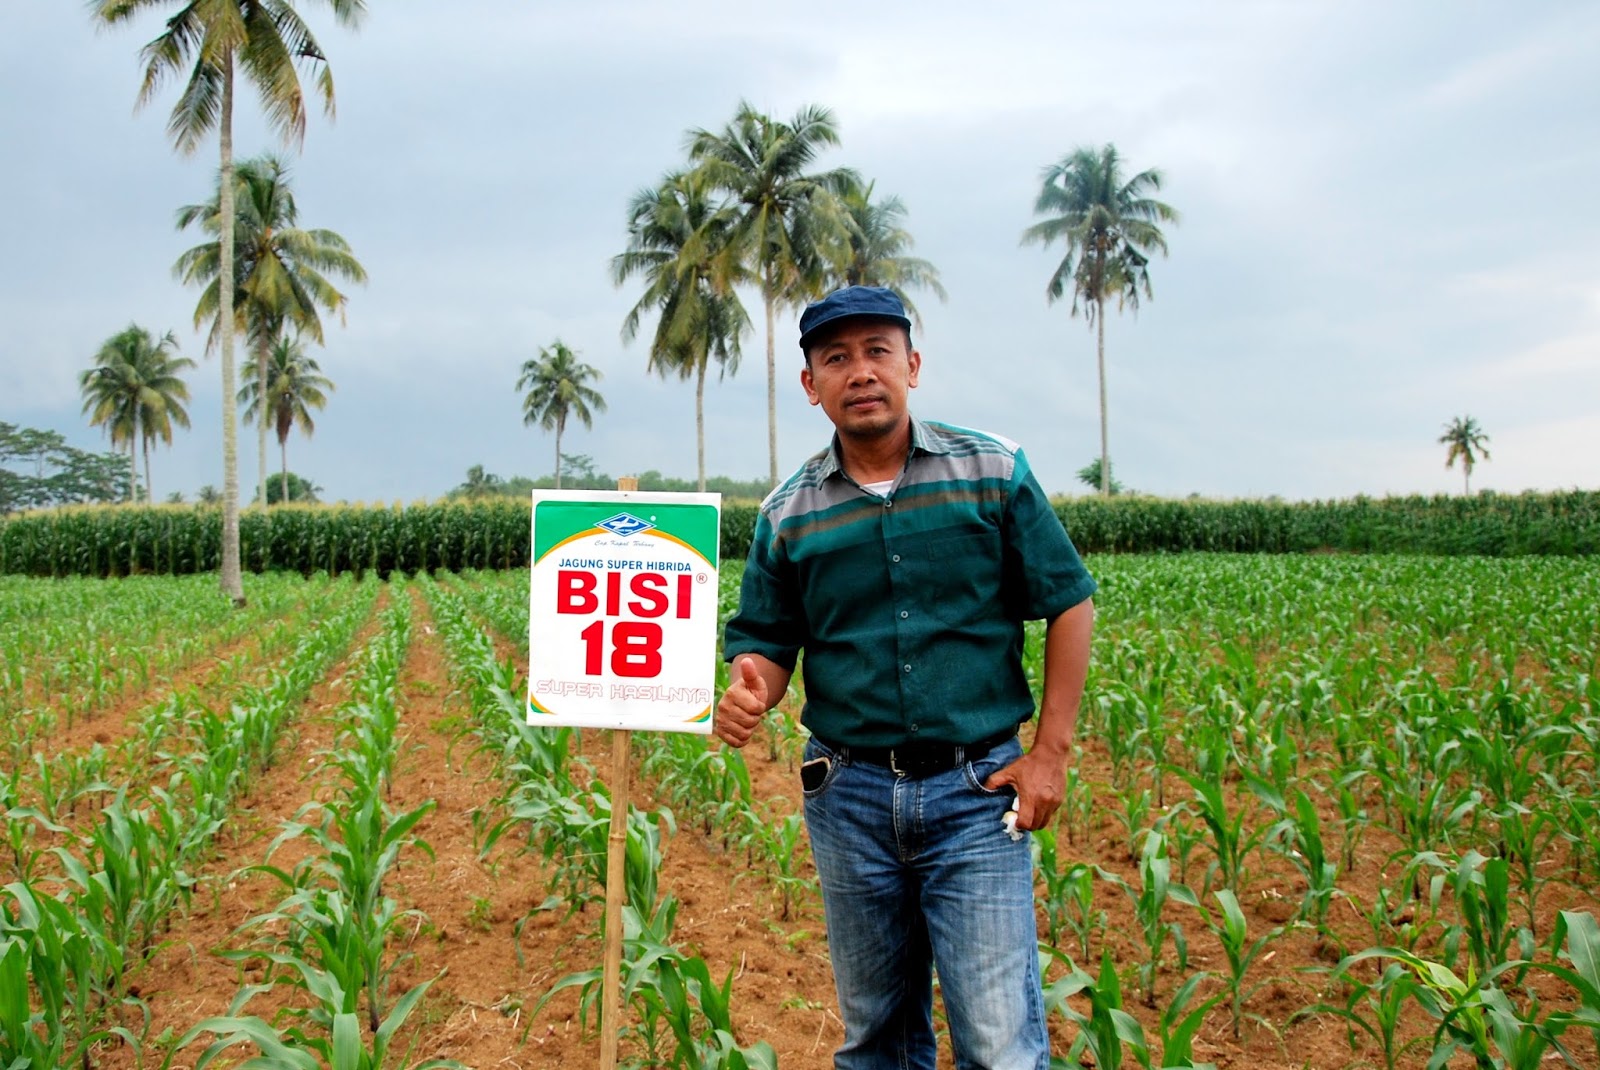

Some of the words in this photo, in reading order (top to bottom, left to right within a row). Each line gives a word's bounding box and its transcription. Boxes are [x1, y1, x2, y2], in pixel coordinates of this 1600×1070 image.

[558, 558, 604, 569] JAGUNG
[607, 559, 643, 570] SUPER
[646, 561, 692, 572] HIBRIDA
[557, 570, 692, 619] BISI
[581, 620, 663, 678] 18
[536, 679, 603, 698] SUPER
[610, 683, 711, 704] HASILNYA
